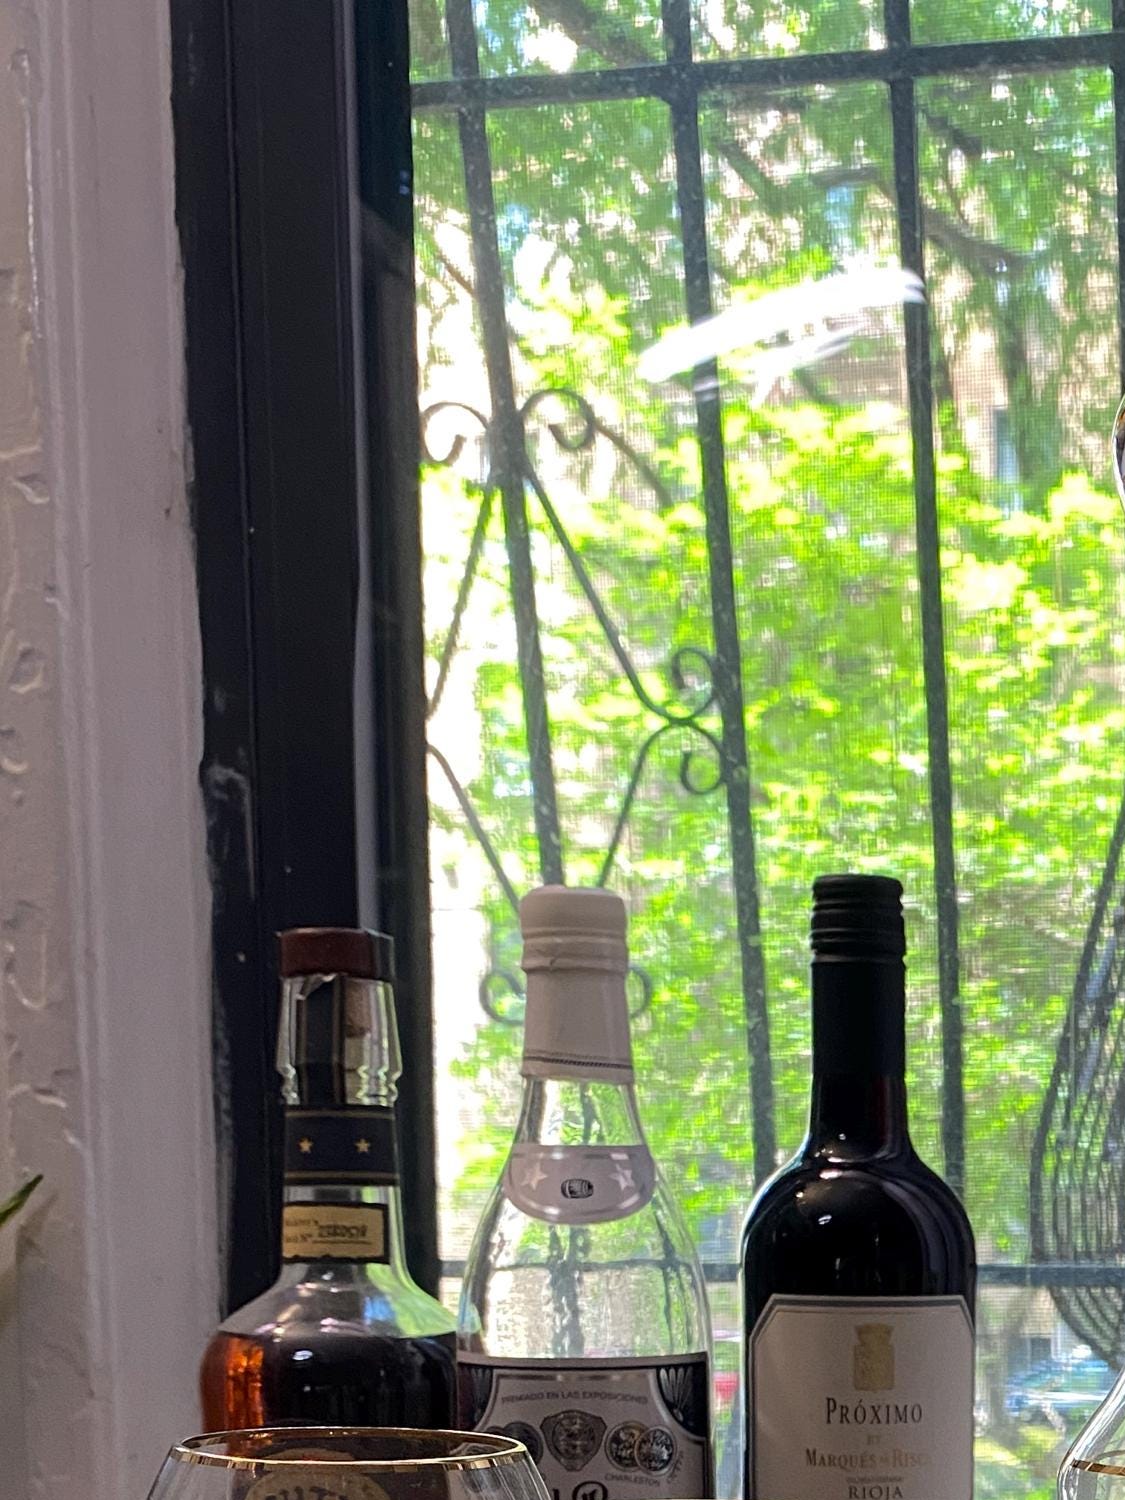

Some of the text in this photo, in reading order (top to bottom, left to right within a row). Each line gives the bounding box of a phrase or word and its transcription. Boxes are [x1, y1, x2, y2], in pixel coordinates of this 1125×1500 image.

[825, 1396, 923, 1425] PRÓXIMO
[805, 1447, 878, 1472] MARQUÉS
[848, 1485, 904, 1500] RIOJA
